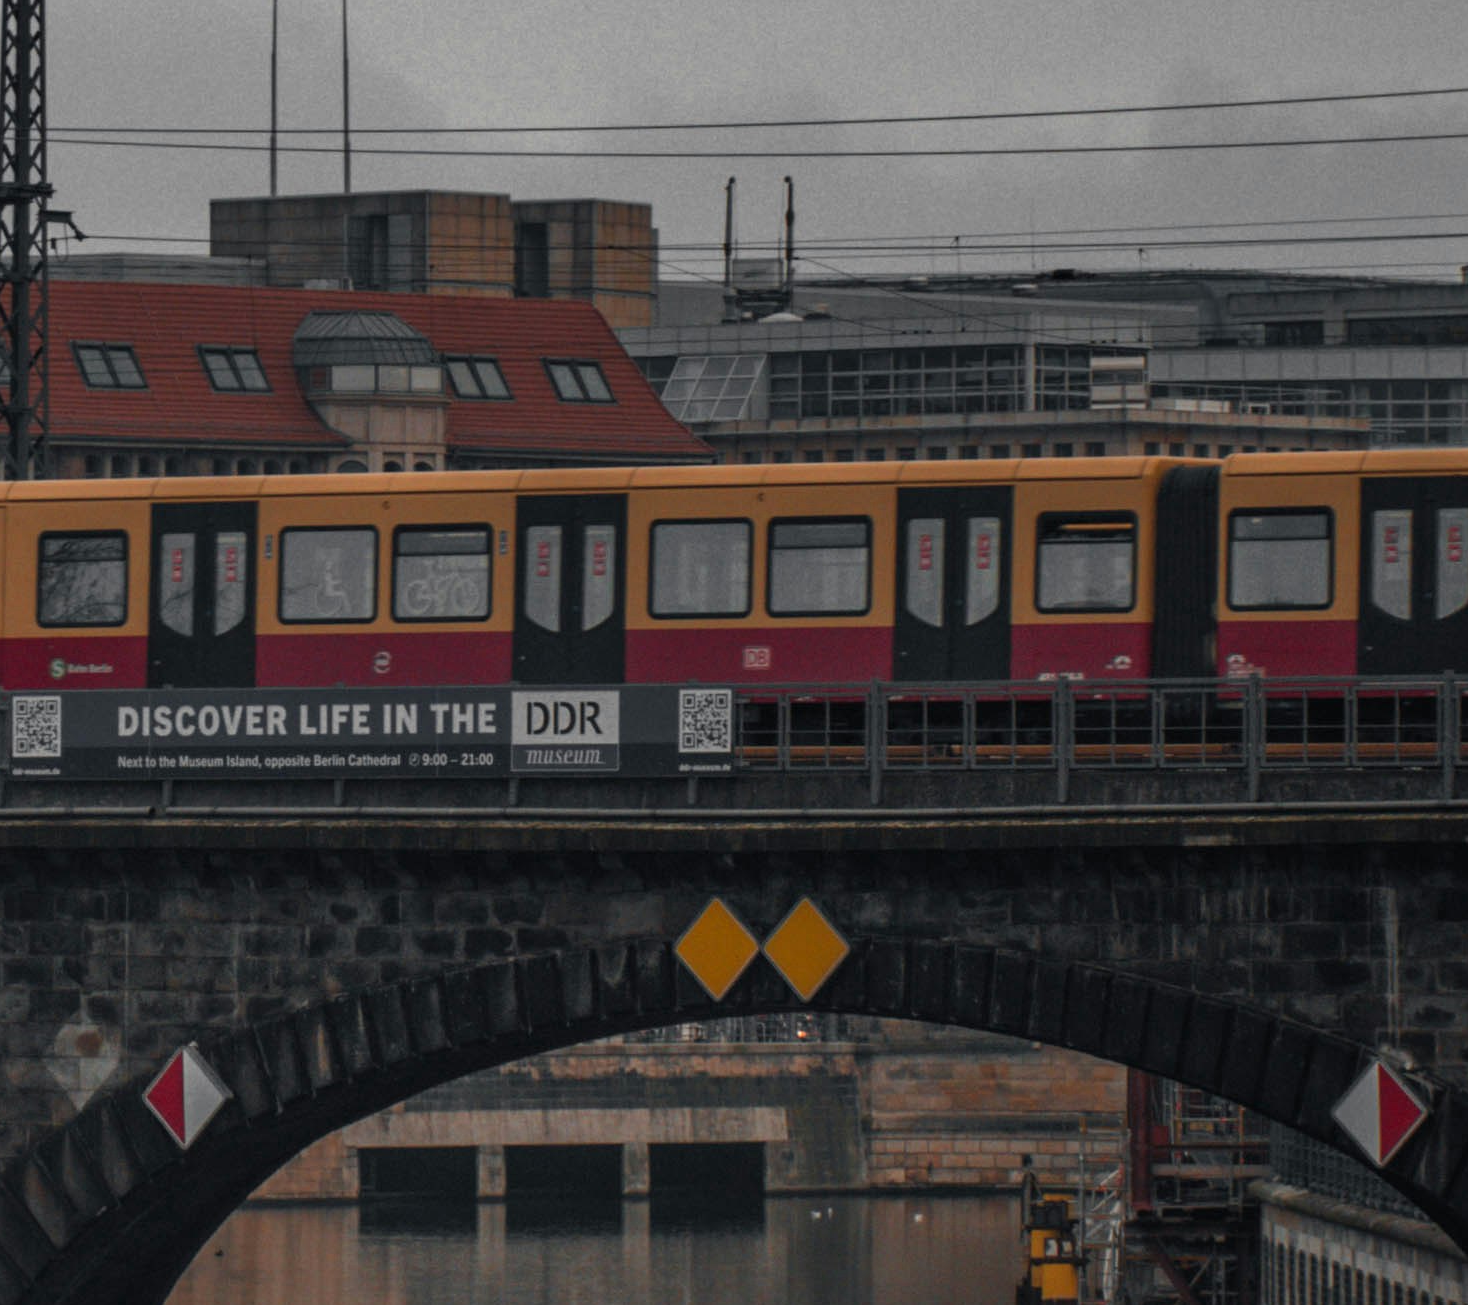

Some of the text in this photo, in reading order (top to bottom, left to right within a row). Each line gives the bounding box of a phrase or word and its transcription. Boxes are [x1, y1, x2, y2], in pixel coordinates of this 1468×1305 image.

[746, 649, 769, 667] DB
[50, 659, 66, 681] S
[118, 702, 498, 736] DISCOVER LIFE IN THE
[526, 701, 603, 735] DDR
[118, 755, 143, 769] Next
[144, 756, 157, 769] to
[159, 755, 177, 769] the
[178, 755, 224, 769] Museum
[226, 755, 262, 770] Island,
[264, 754, 312, 771] opposite
[314, 754, 346, 767] Berlin
[348, 753, 401, 767] Cathedral
[422, 753, 449, 767] 9:00
[460, 752, 494, 766] 21:00
[526, 748, 602, 765] museum
